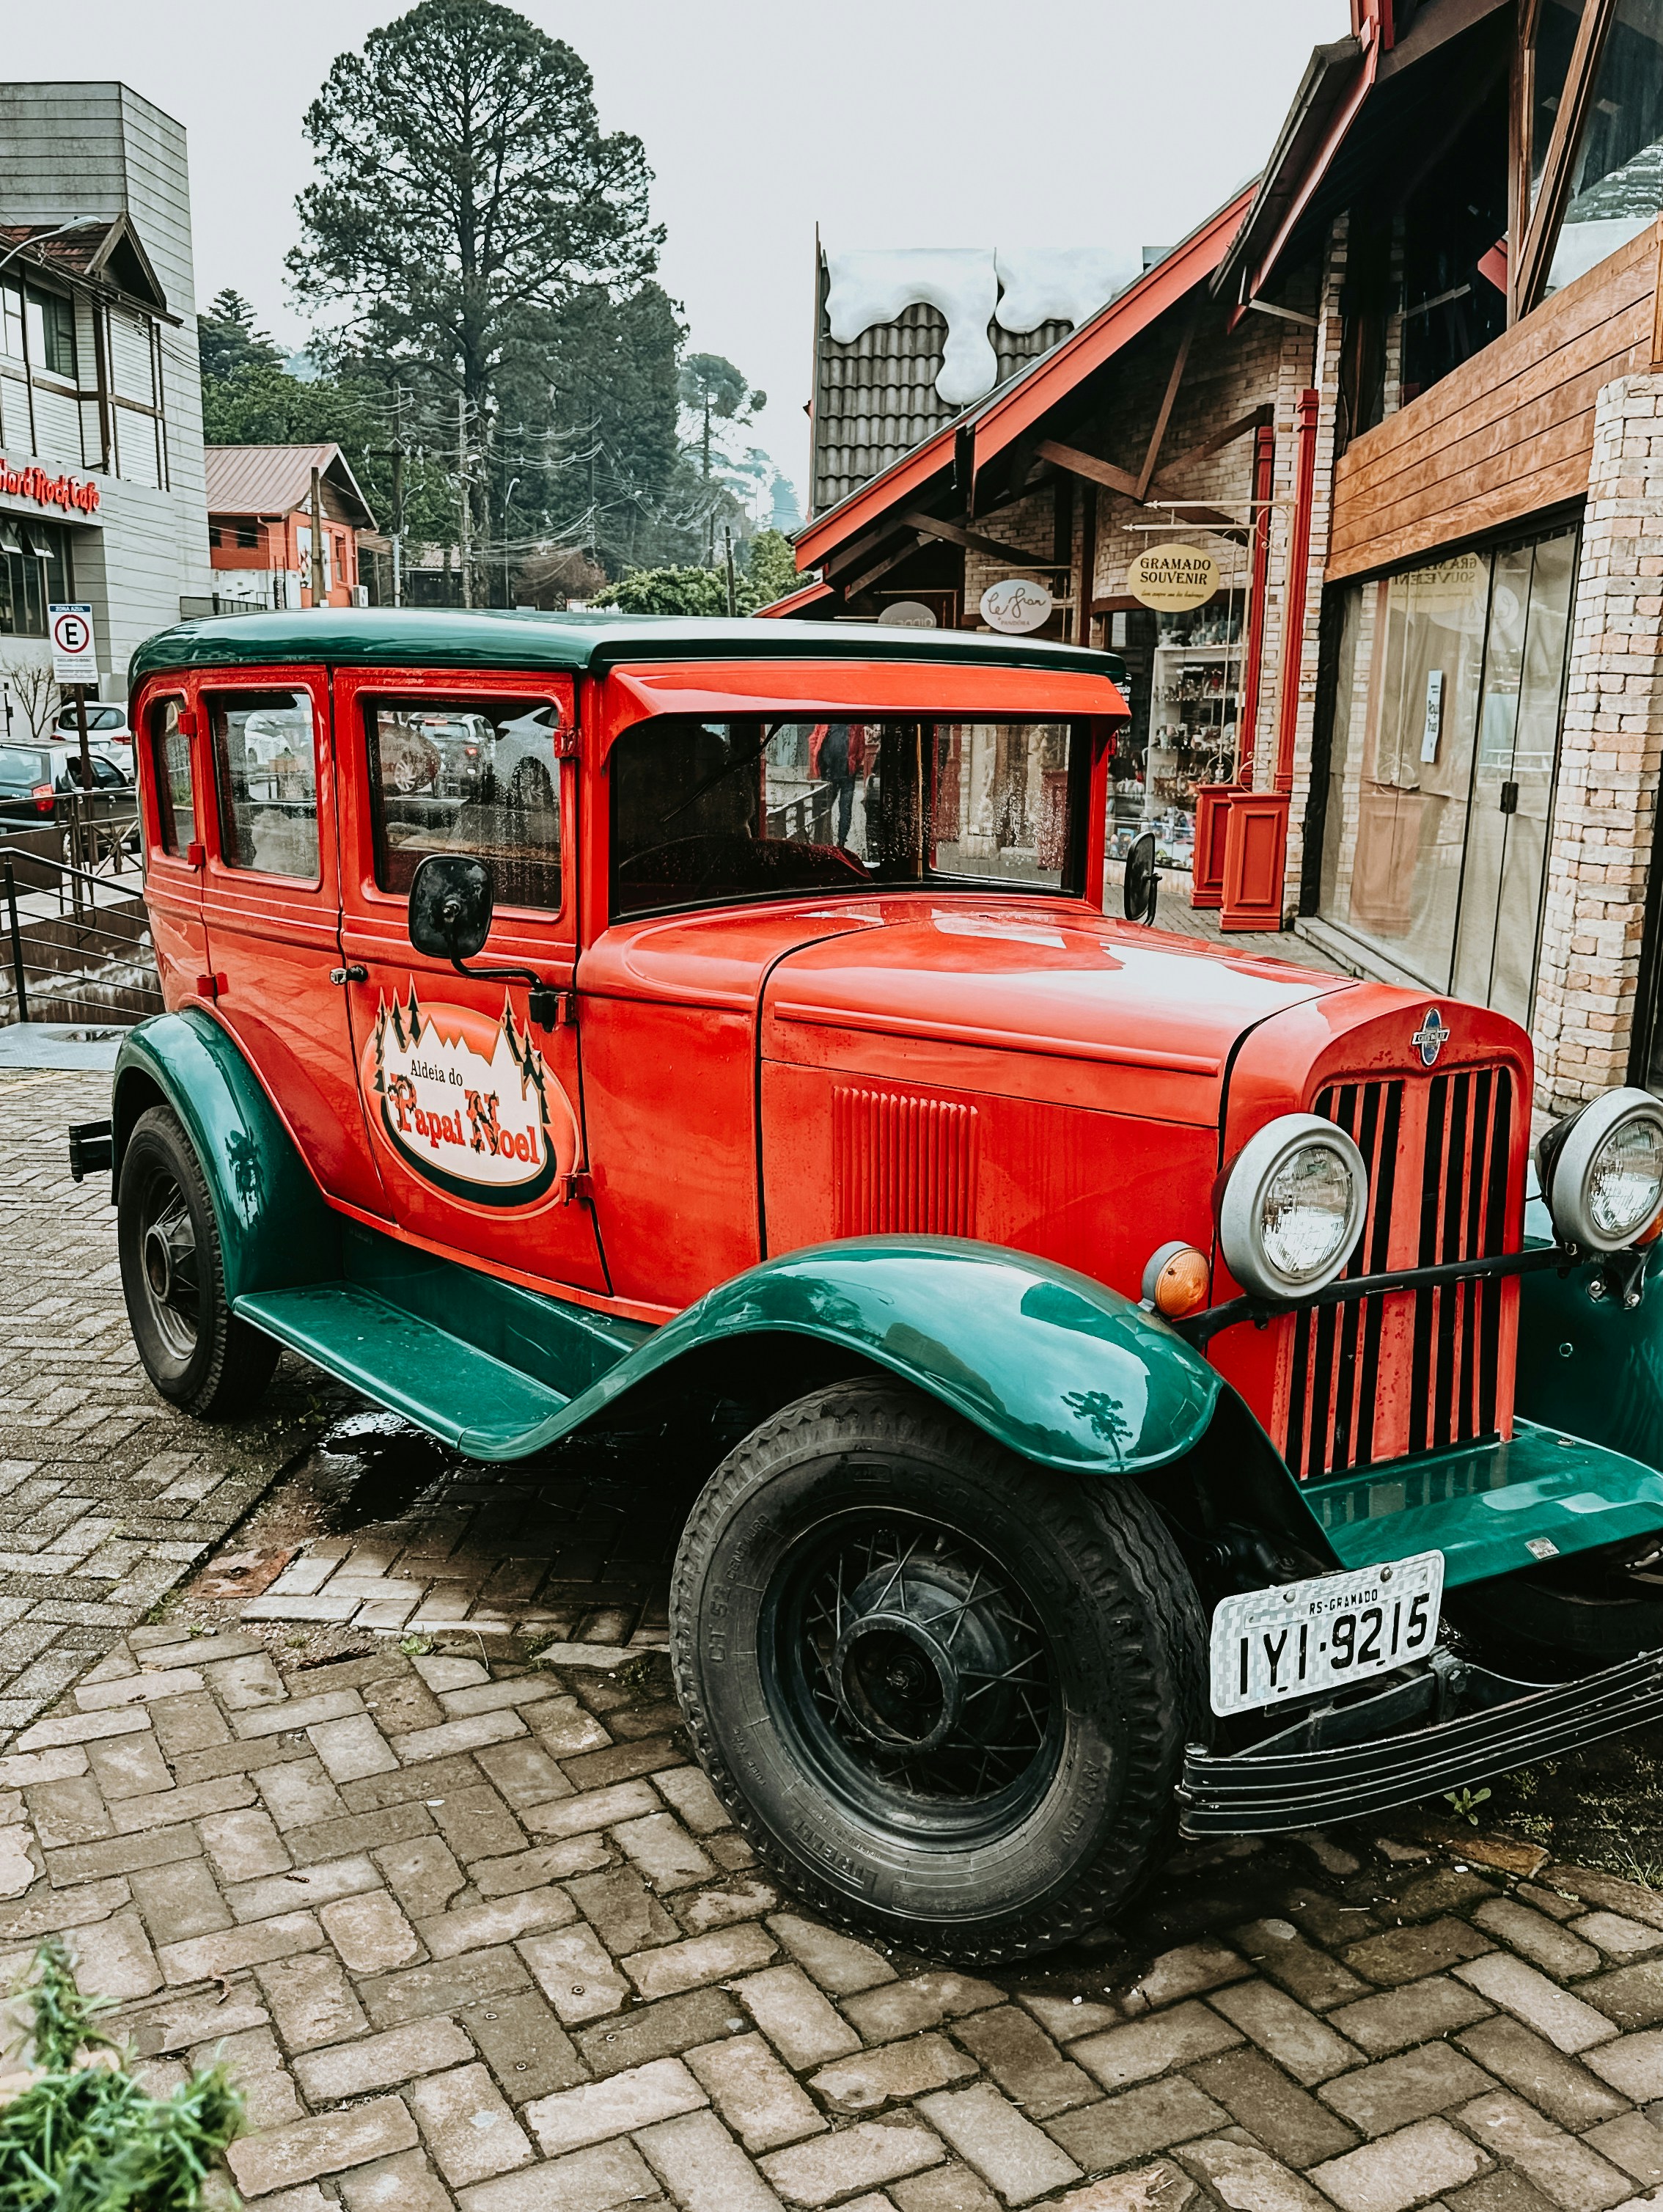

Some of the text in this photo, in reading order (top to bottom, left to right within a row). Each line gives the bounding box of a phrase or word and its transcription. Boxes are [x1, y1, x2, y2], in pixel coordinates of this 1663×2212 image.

[33, 467, 71, 512] Rock
[1140, 557, 1211, 571] GRAMADO
[1139, 571, 1208, 585] SOUVENIR
[65, 623, 78, 645] E
[410, 1059, 463, 1087] Aldeia do
[387, 1073, 541, 1165] Papai Noel
